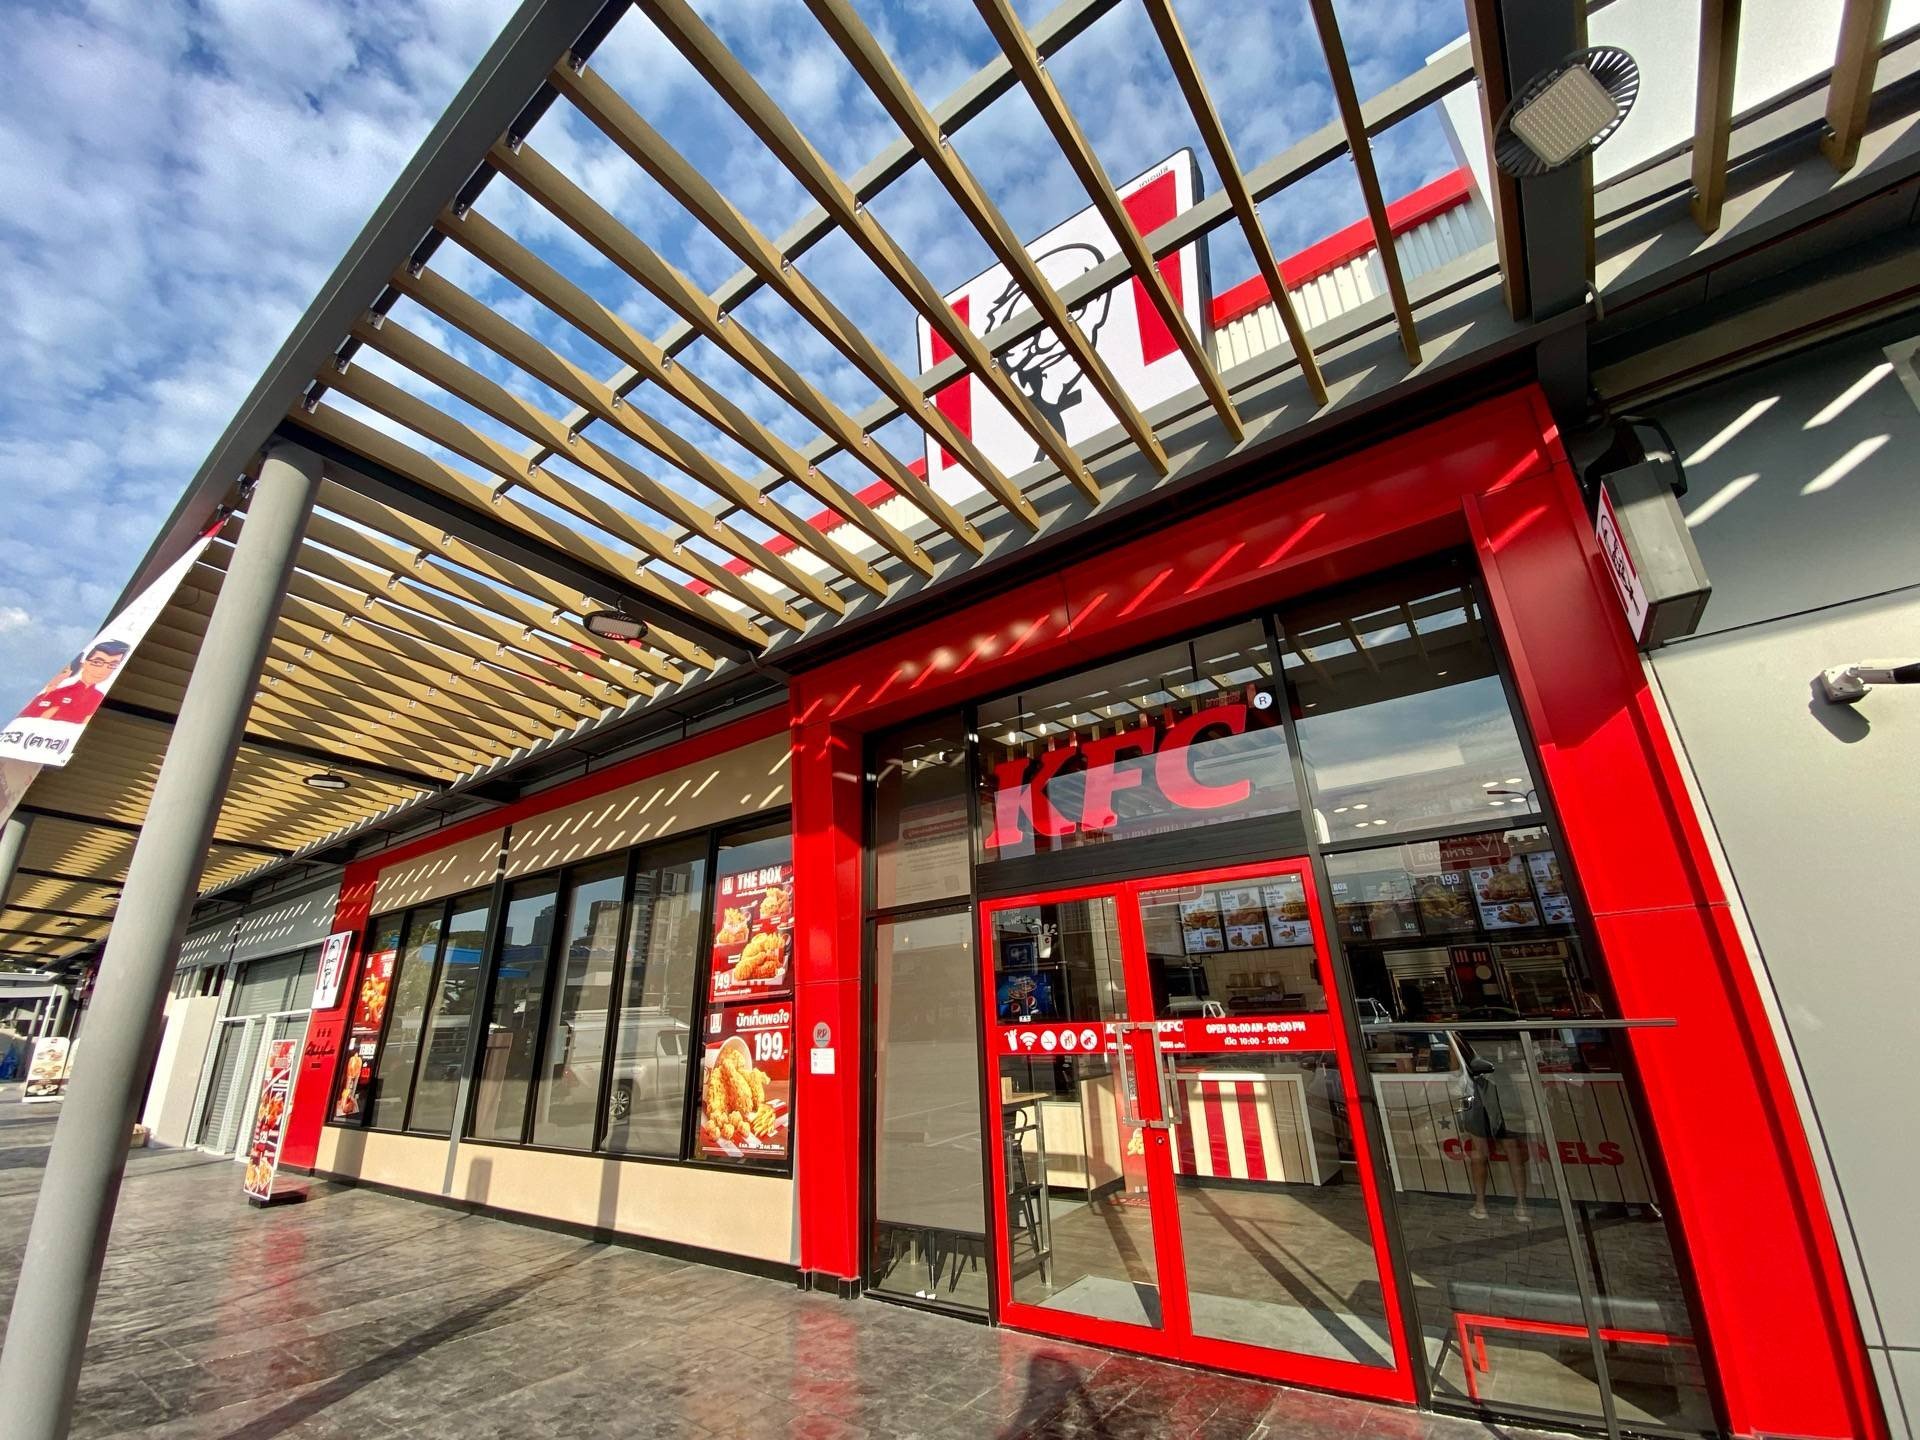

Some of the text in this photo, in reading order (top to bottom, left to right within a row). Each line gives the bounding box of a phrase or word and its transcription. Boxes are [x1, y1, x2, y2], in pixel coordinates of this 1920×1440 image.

[985, 704, 1250, 849] KFC
[737, 870, 758, 890] THE
[760, 866, 782, 885] BOX
[1157, 1020, 1184, 1032] KFC
[1206, 1023, 1227, 1034] OPEN
[1228, 1023, 1250, 1033] 10:00
[1239, 1037, 1260, 1045] 10:00
[1268, 1037, 1290, 1045] 21:00
